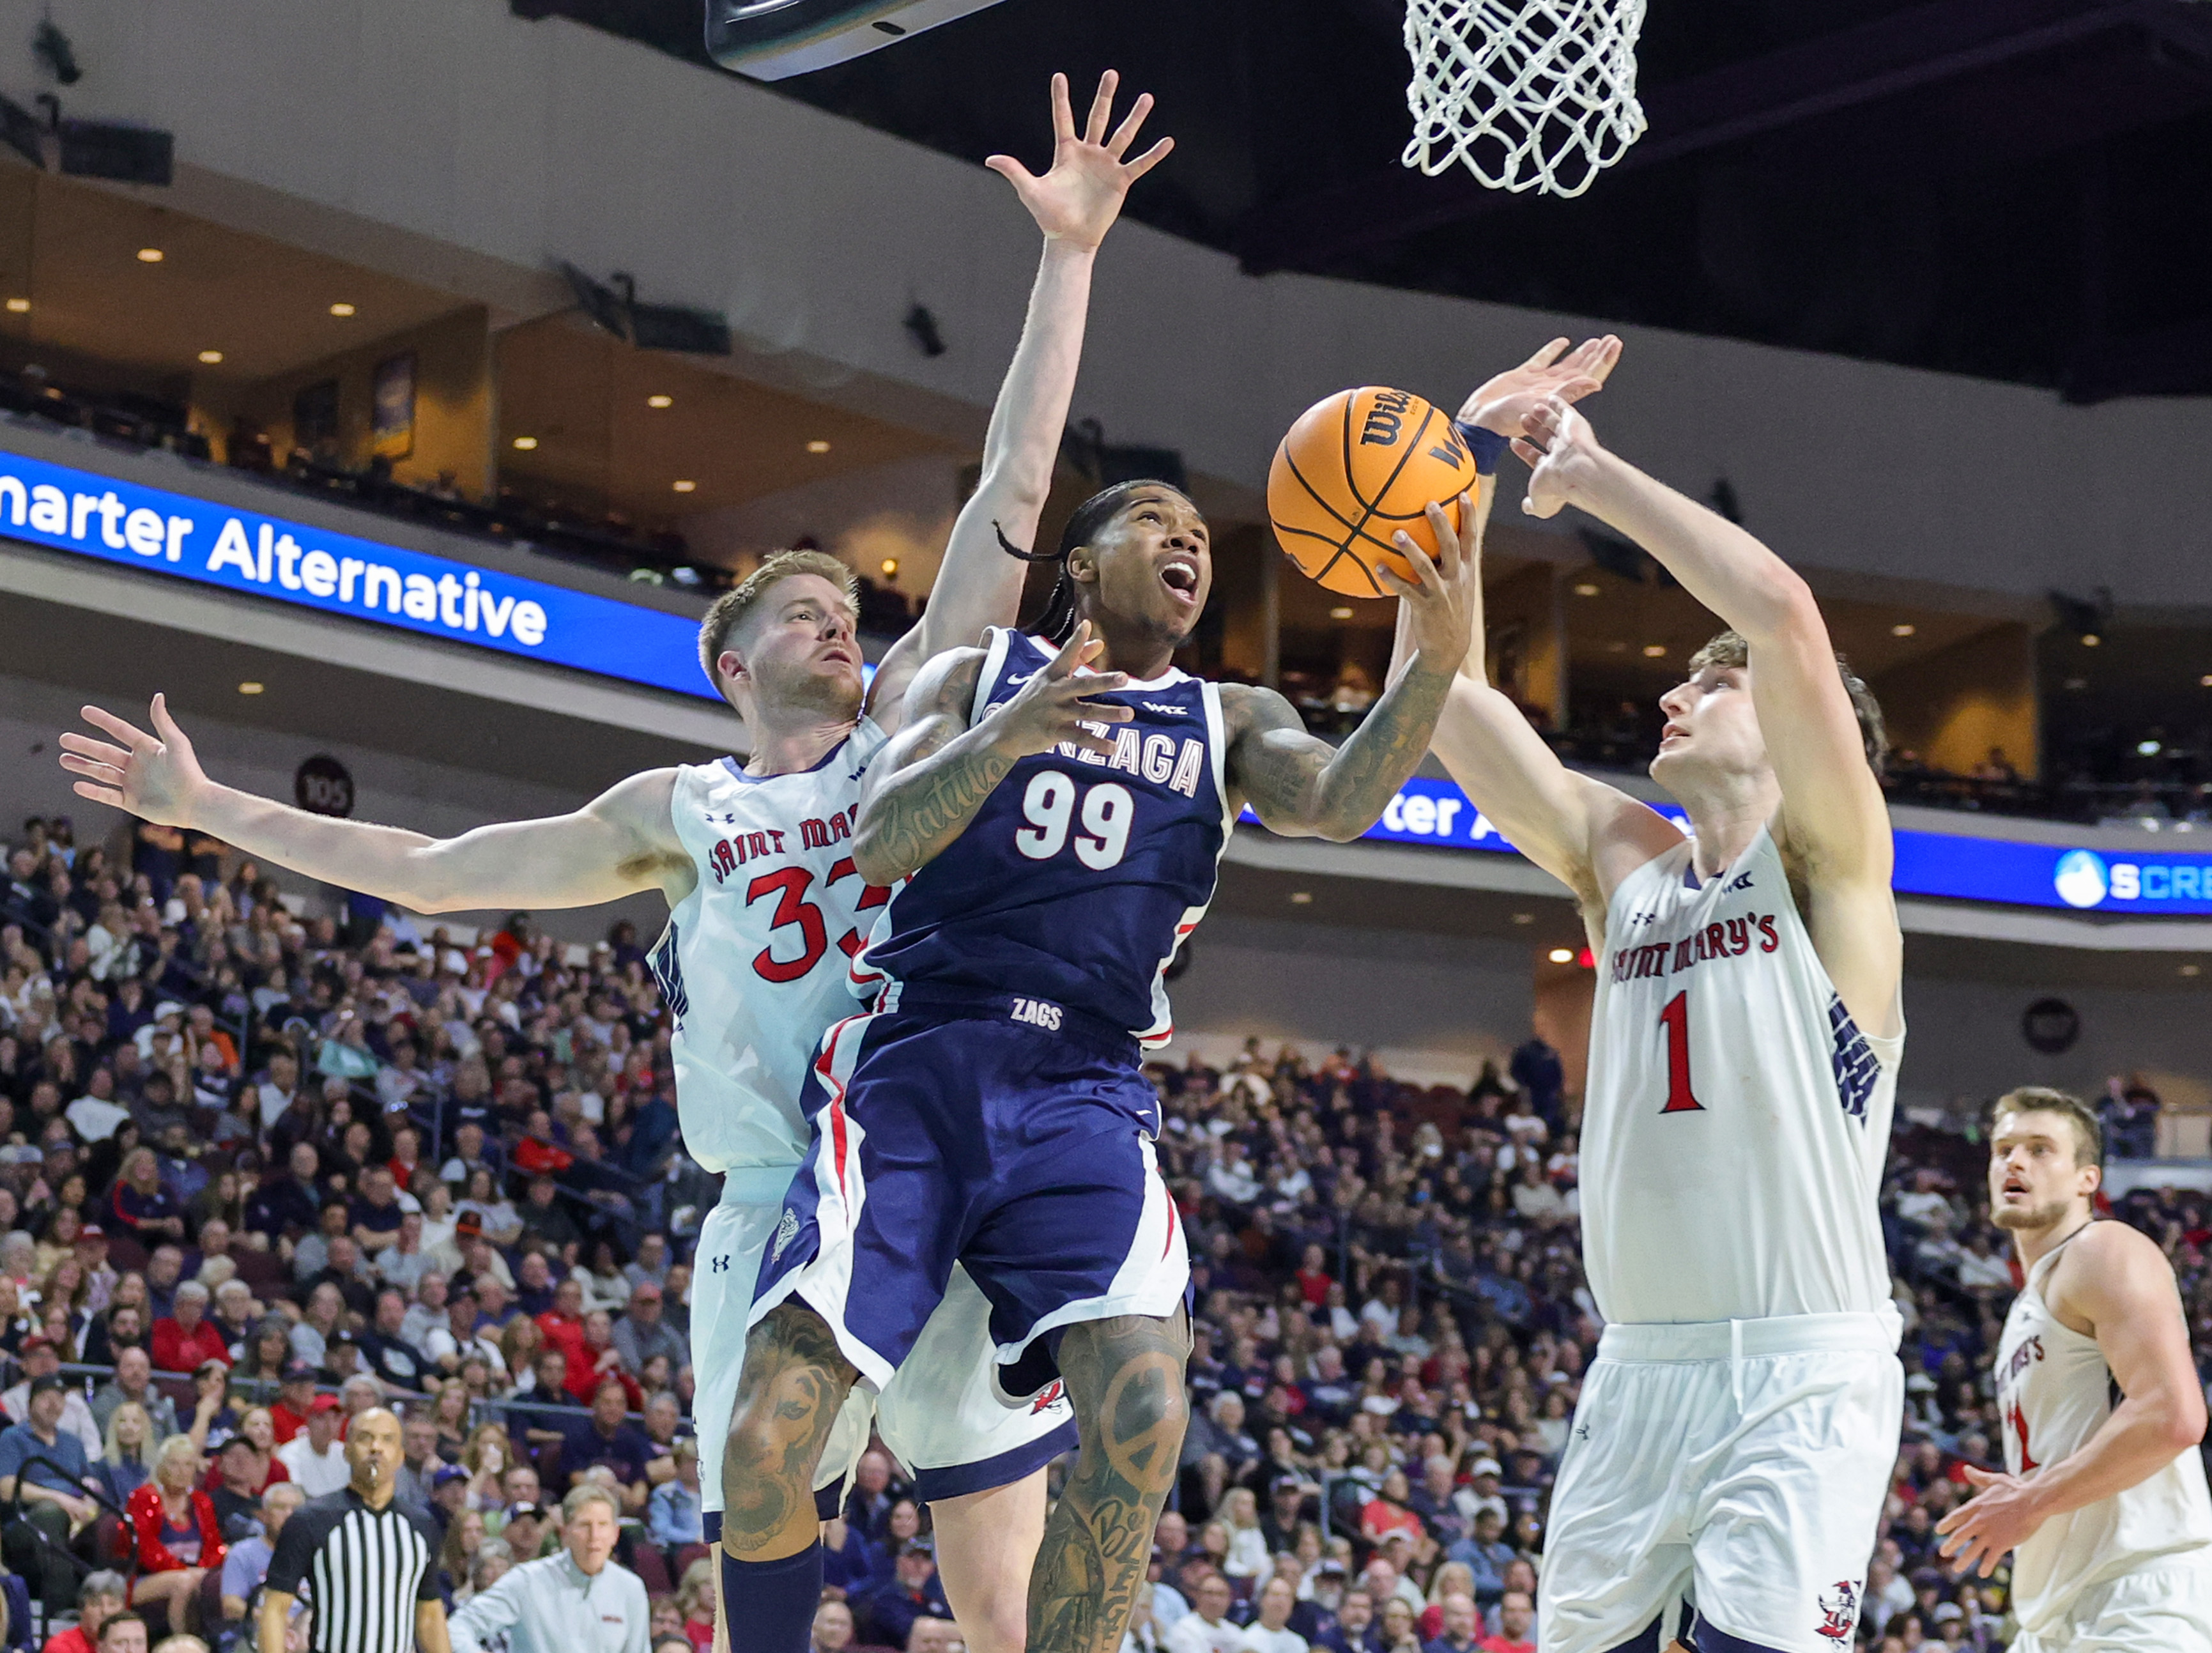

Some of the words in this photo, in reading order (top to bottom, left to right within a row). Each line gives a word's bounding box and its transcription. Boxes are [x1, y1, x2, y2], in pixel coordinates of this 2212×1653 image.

[206, 518, 548, 646] Alternative
[709, 829, 785, 884] SAINT
[1014, 769, 1135, 871] 99
[1010, 997, 1063, 1031] ZAGS
[1659, 990, 1707, 1114] 1
